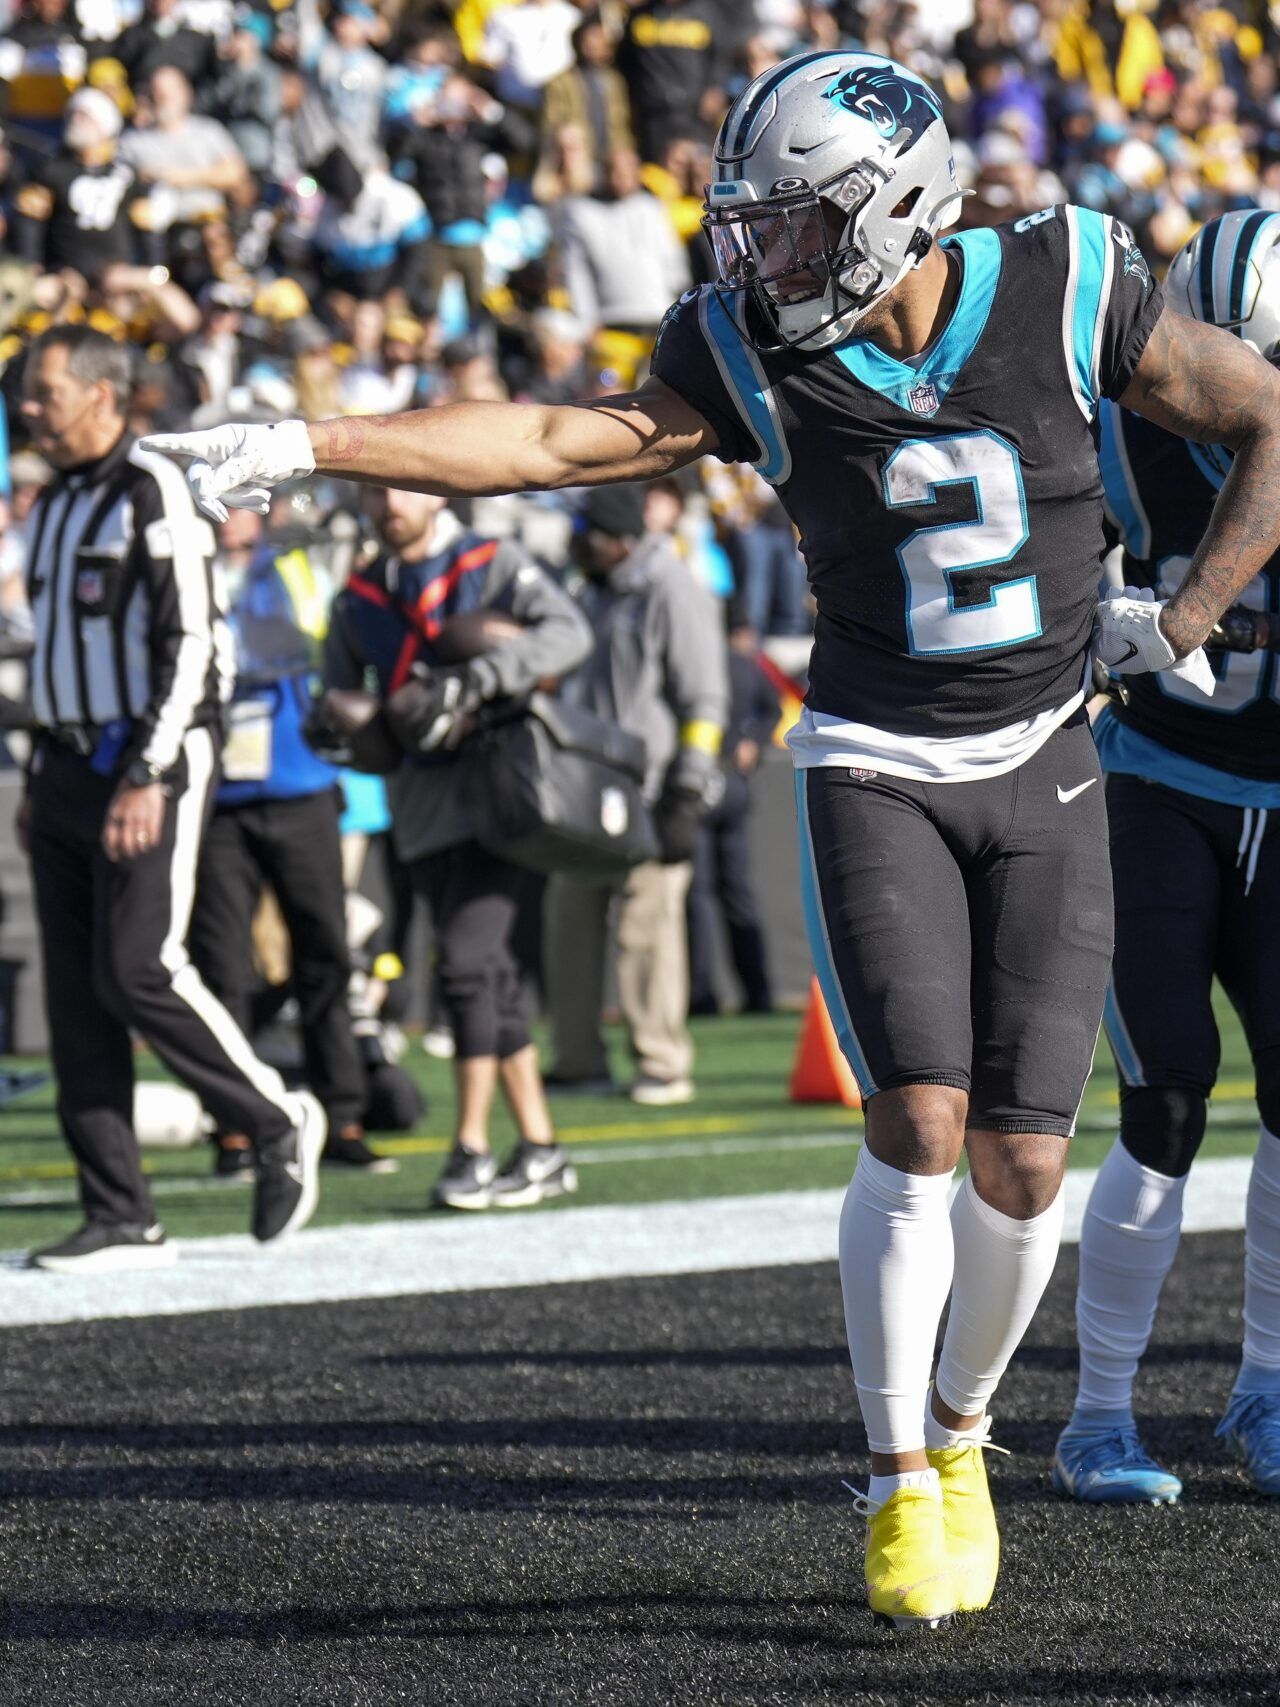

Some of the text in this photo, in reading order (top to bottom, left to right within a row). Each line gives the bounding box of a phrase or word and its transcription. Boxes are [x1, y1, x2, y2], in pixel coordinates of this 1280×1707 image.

[1013, 203, 1056, 233] 2
[912, 395, 936, 412] NFL
[881, 428, 1043, 656] 2
